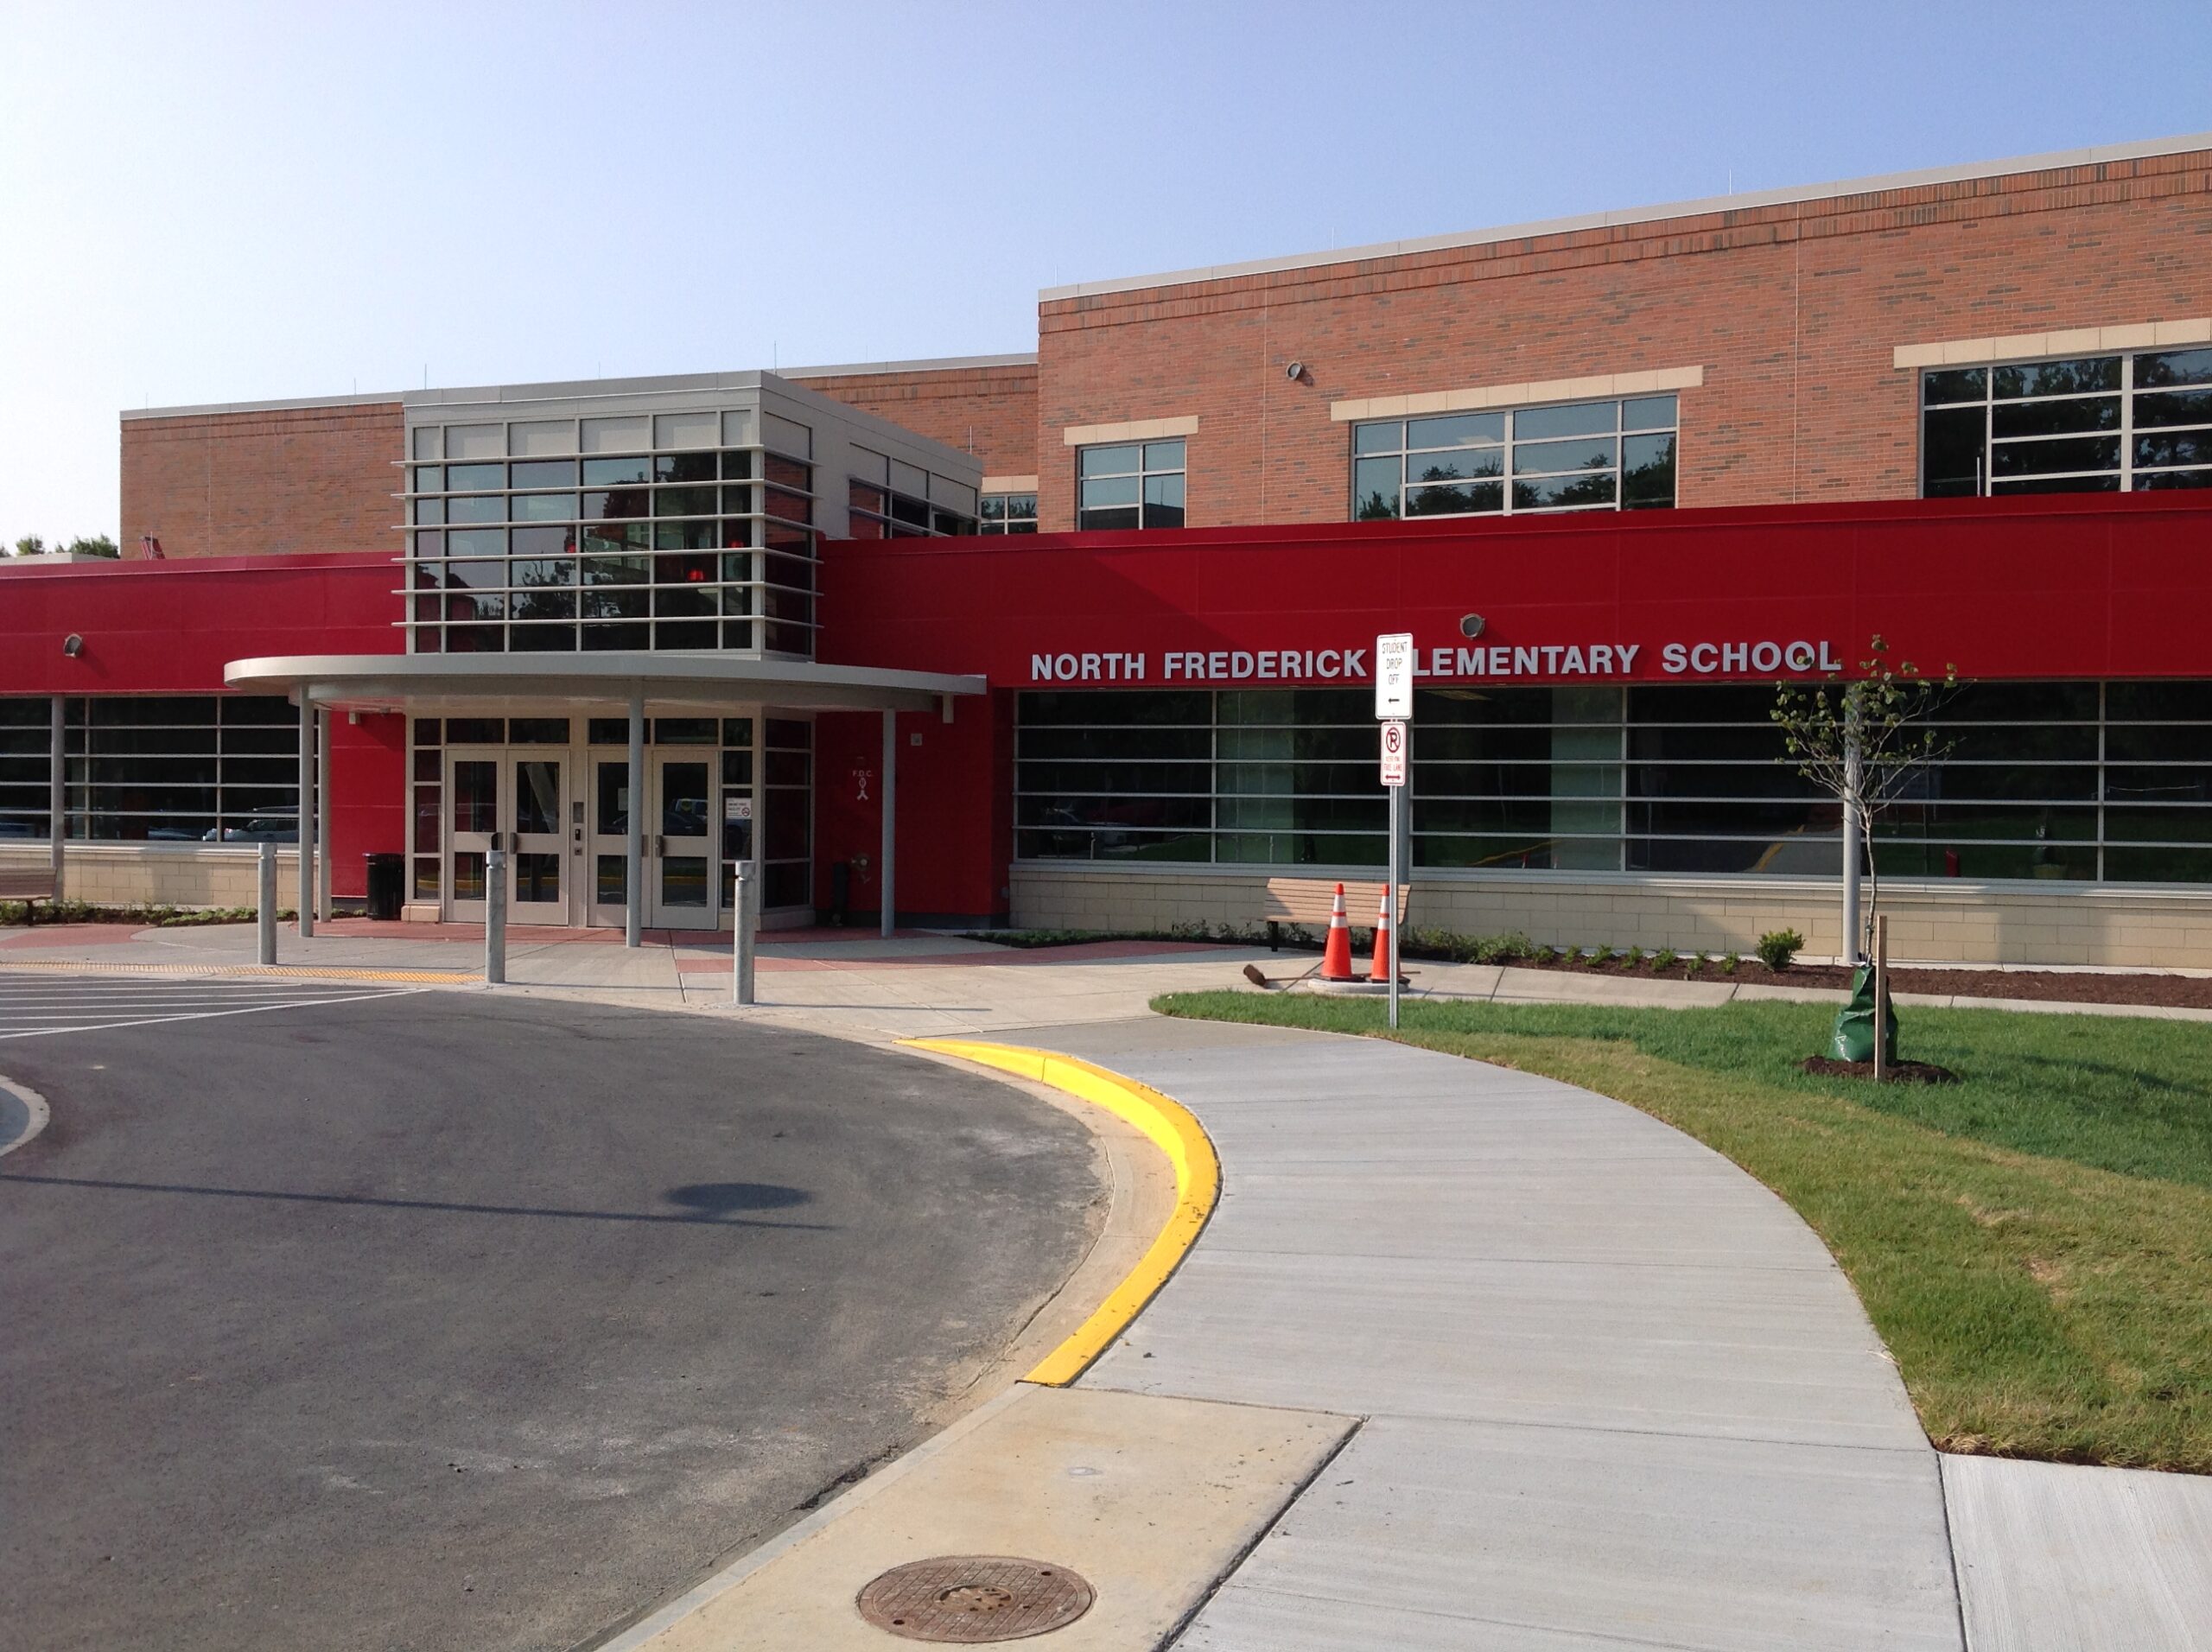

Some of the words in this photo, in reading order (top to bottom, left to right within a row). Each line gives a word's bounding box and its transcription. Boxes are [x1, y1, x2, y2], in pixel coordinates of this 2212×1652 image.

[1382, 641, 1408, 654] STUDENT
[1032, 653, 1145, 680] NORTH
[1164, 650, 1367, 679] FREDERICK
[1413, 645, 1640, 677] LEMENTARY
[1662, 640, 1842, 673] SCHOOL
[1386, 658, 1402, 670] DROP
[1389, 673, 1400, 684] OFF
